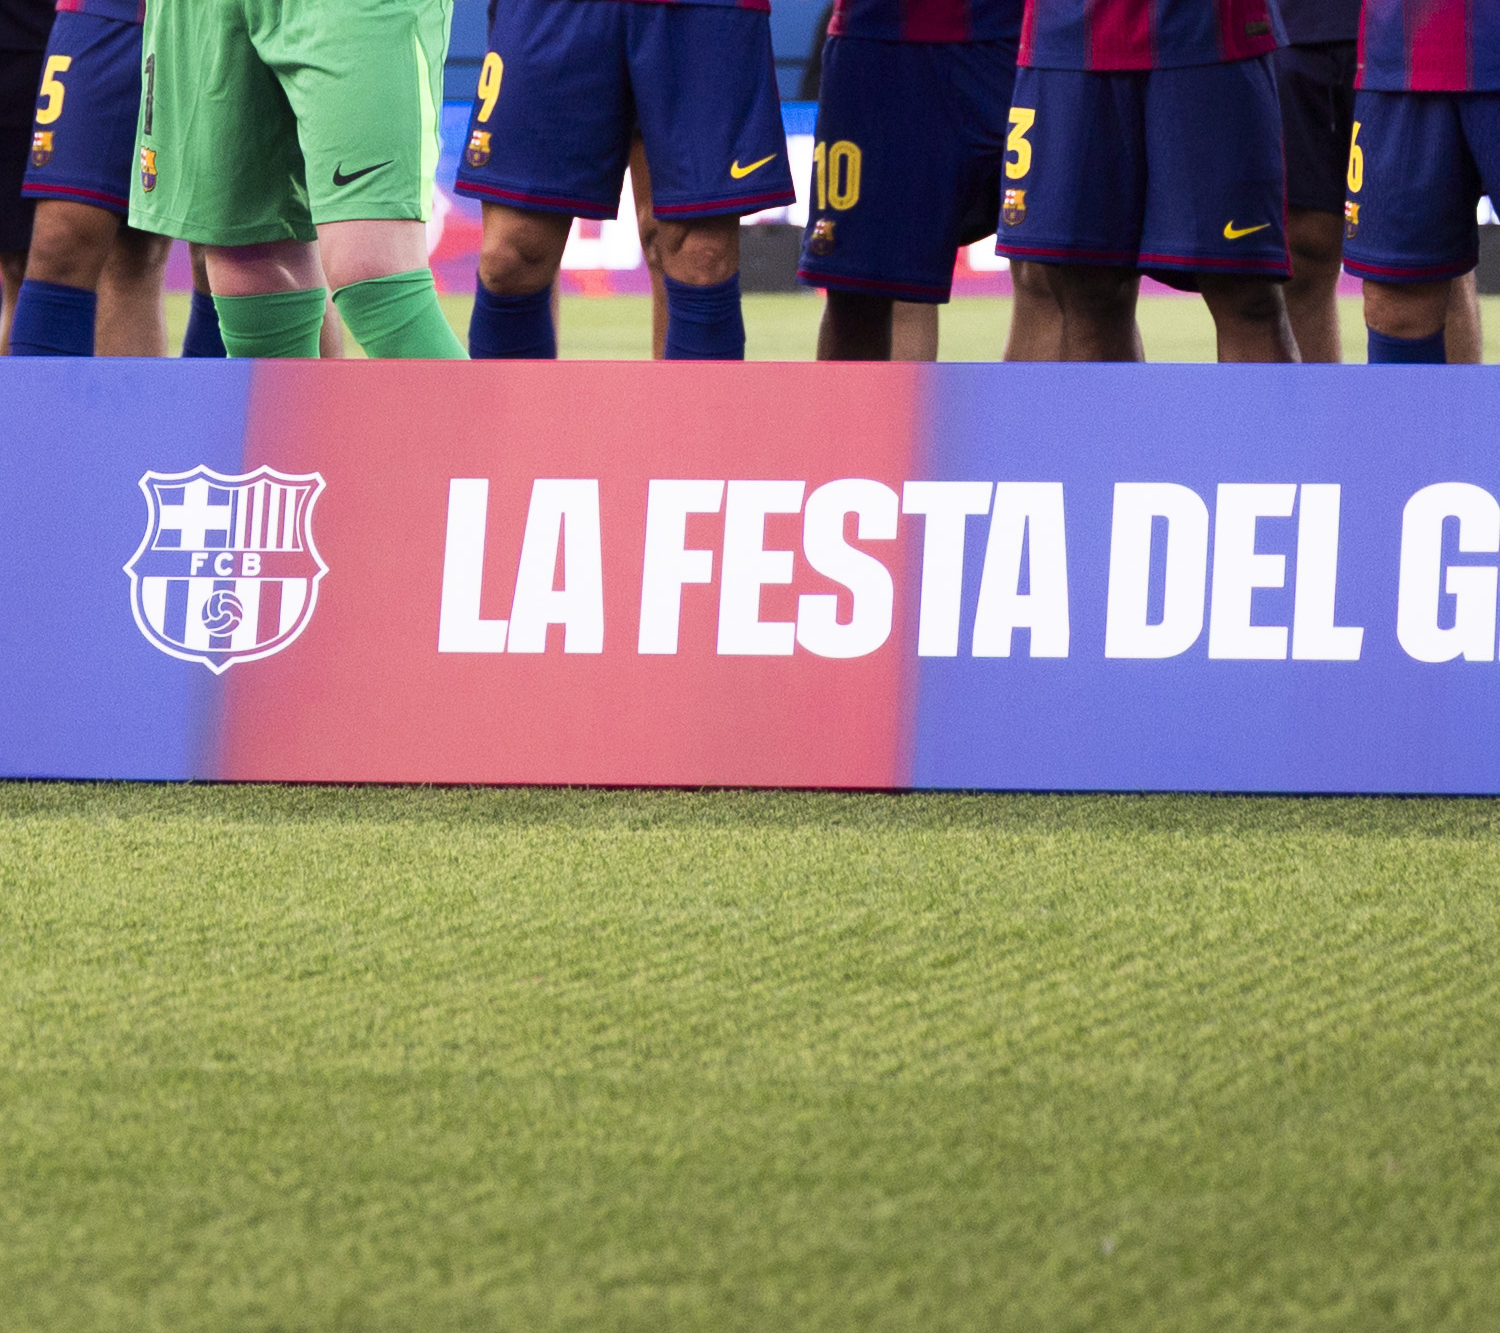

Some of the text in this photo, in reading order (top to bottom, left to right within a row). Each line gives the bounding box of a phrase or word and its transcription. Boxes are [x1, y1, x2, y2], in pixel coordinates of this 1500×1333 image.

[35, 55, 71, 124] 5
[477, 51, 504, 123] 9
[813, 140, 862, 211] 10
[1005, 107, 1035, 179] 3
[190, 552, 262, 576] FCB
[437, 478, 604, 653] LA
[638, 478, 1070, 658] FESTA
[1104, 482, 1365, 661] DEL
